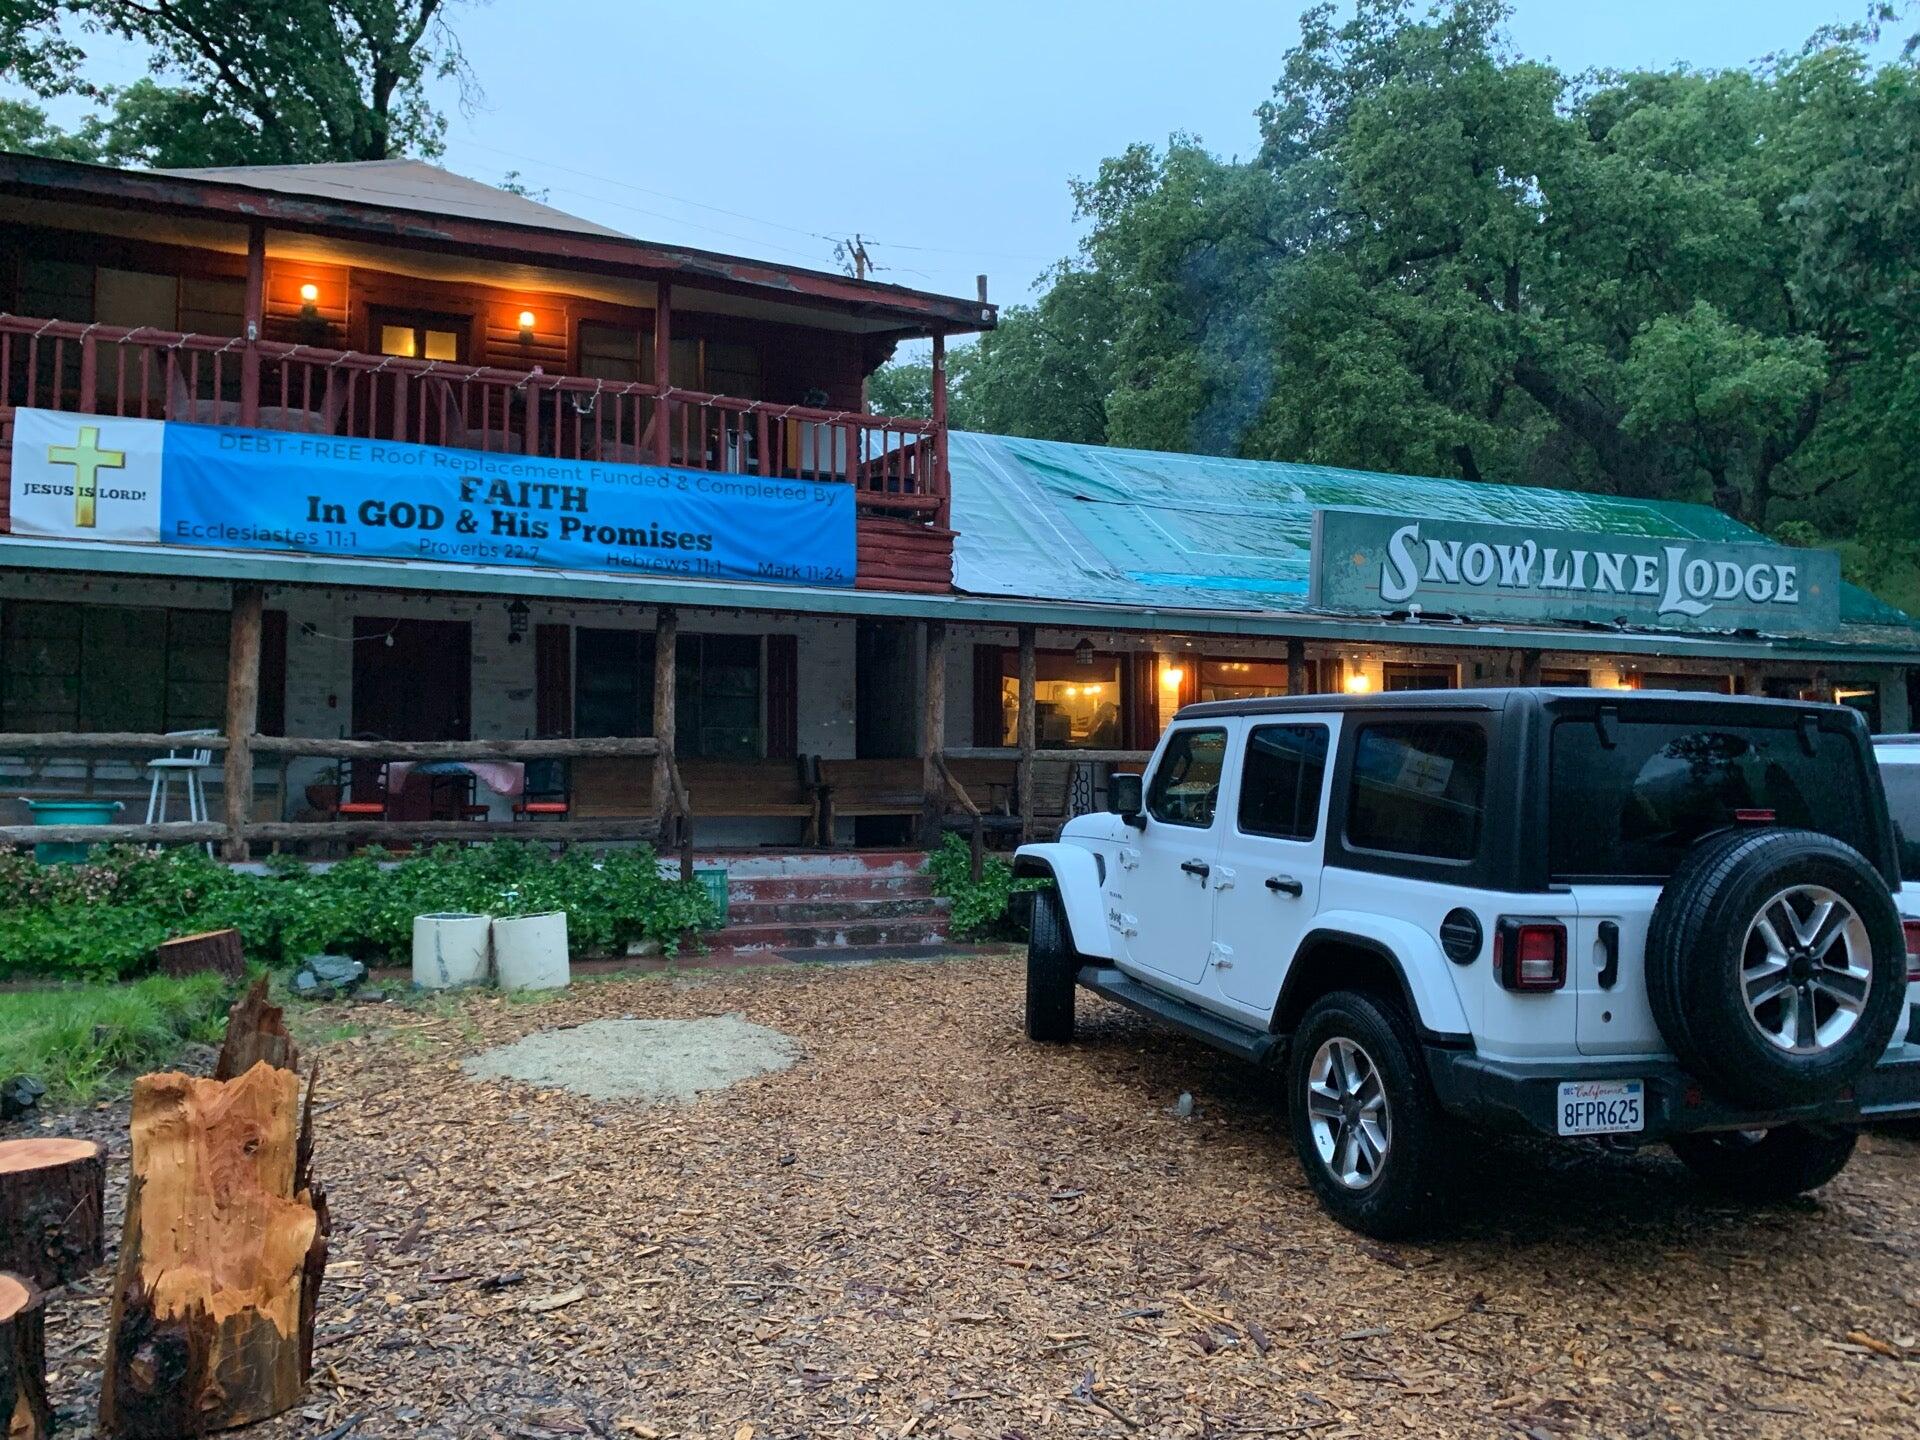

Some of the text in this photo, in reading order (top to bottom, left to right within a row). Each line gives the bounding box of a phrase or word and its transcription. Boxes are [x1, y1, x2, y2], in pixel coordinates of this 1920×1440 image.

[220, 433, 838, 506] DEBT-FREE Roof Replacement Funded & Completed By
[24, 483, 146, 501] JESUS IS LORD!
[458, 476, 588, 512] FAITH
[176, 520, 357, 547] Ecclesiastes 11:1
[307, 496, 713, 551] In GOD & His Promises
[419, 538, 539, 560] Proverbs 22:7
[606, 552, 721, 575] Hebrews 11:1
[758, 562, 843, 581] Mark 11:24
[1575, 1083, 1624, 1100] California
[1565, 1099, 1639, 1127] 8FPR625
